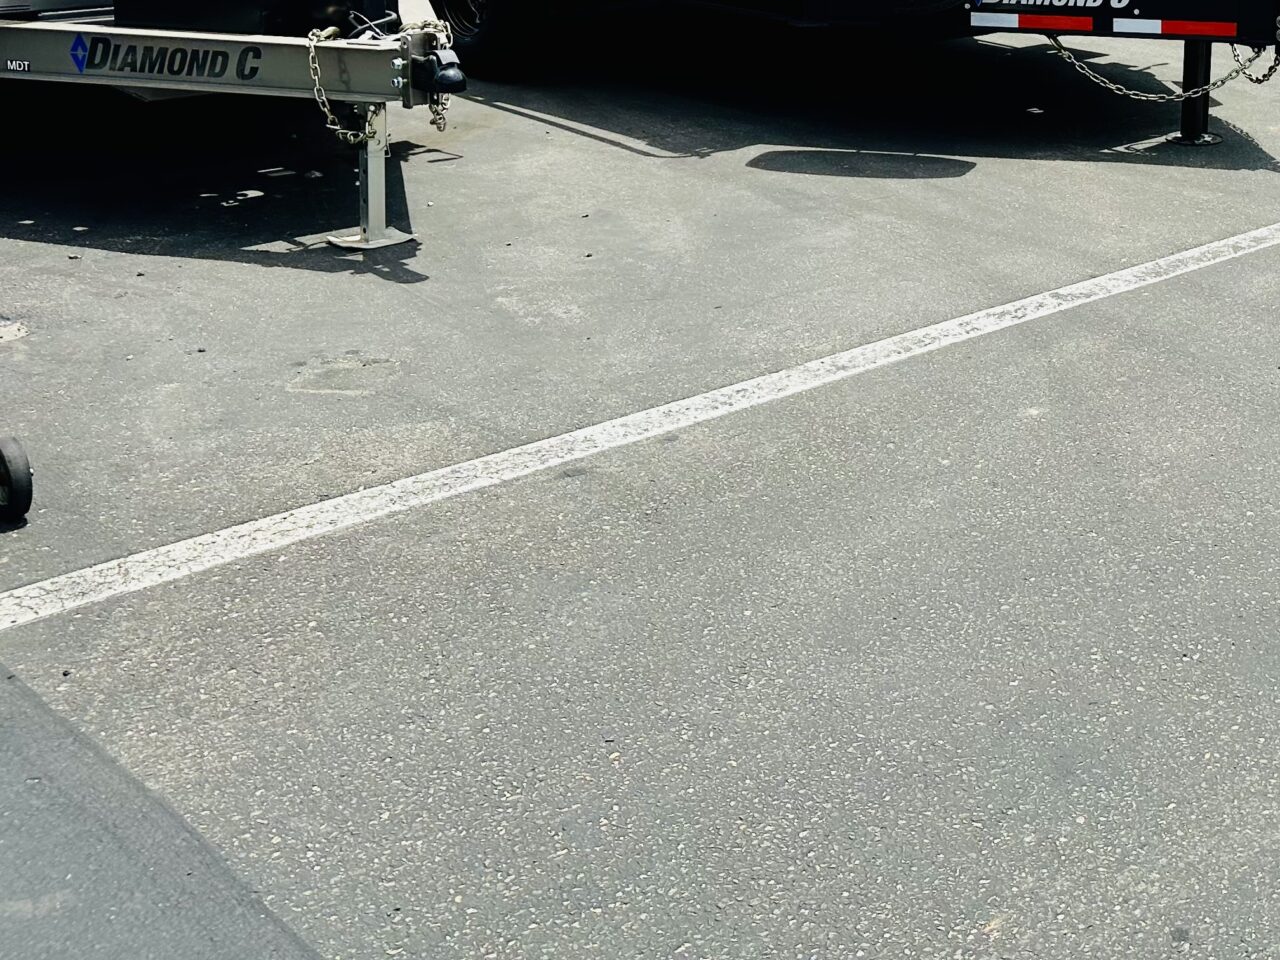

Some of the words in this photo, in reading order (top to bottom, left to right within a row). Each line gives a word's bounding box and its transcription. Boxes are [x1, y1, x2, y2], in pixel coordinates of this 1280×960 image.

[7, 60, 30, 71] MDT
[84, 36, 230, 78] DIAMOND
[236, 45, 262, 80] C
